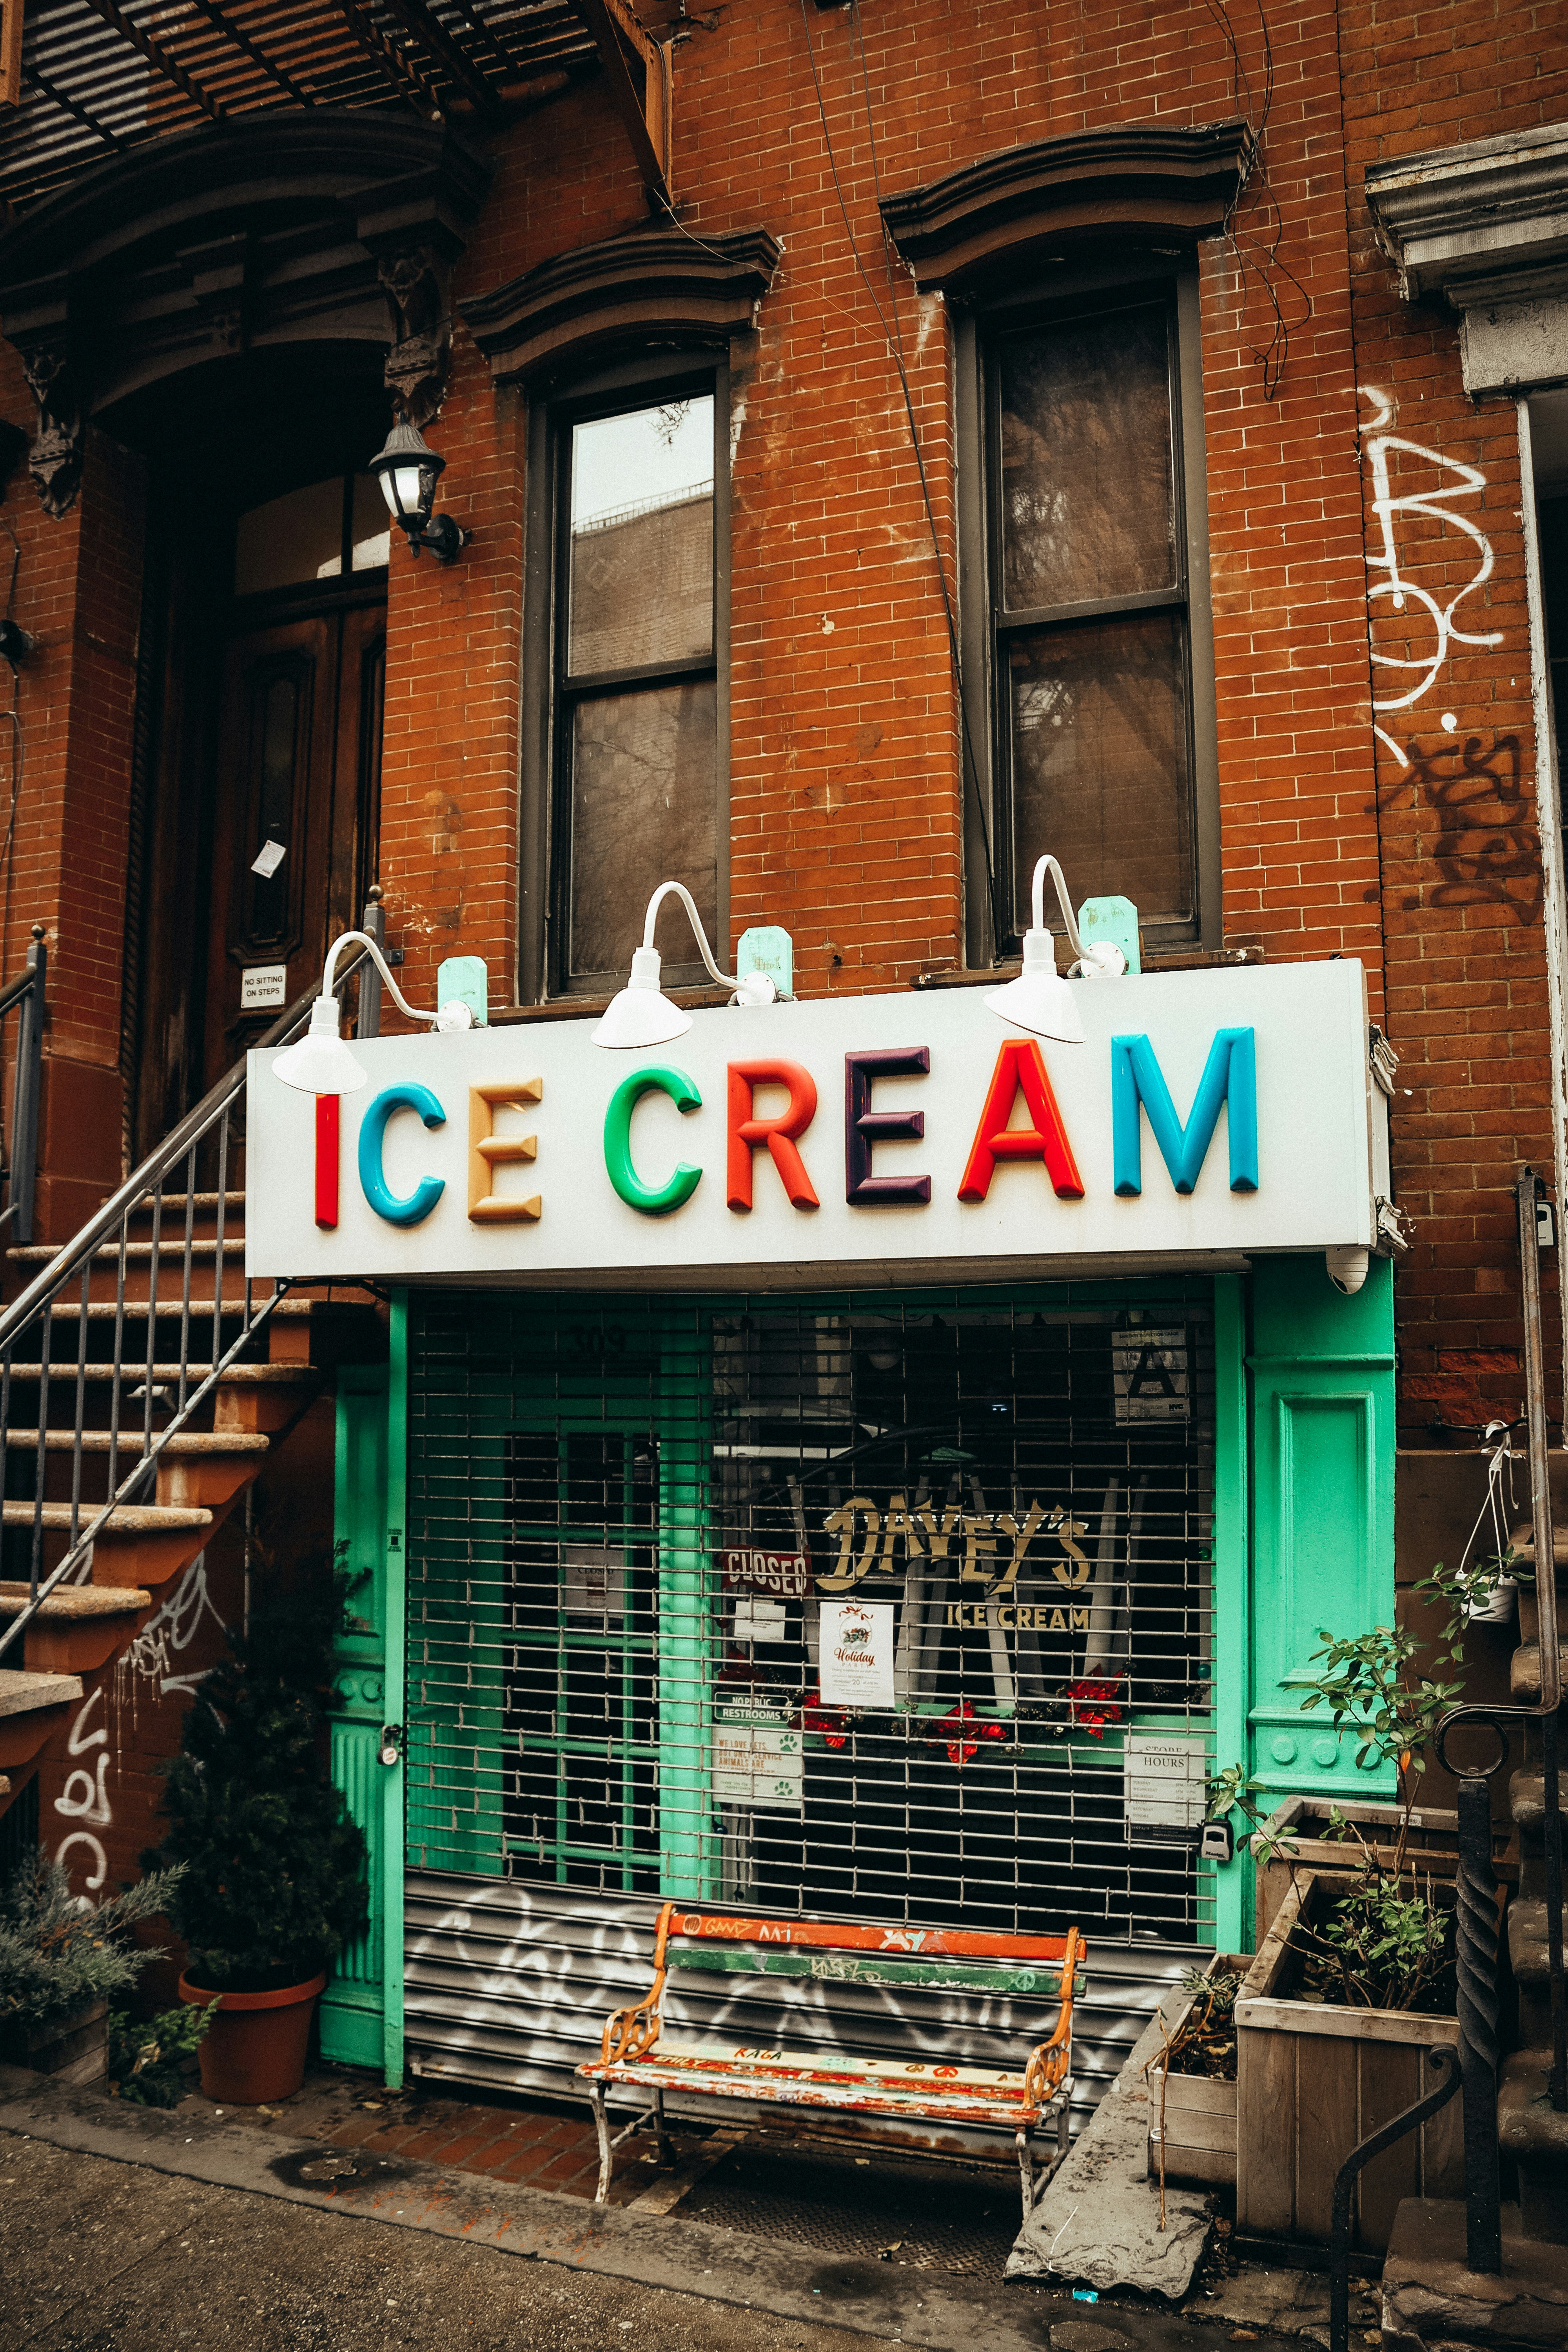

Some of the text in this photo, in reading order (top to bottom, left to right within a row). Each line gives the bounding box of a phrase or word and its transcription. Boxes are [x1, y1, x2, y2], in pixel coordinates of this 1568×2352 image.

[256, 976, 283, 984] SITTING
[314, 1026, 1259, 1230] ICE CREAM
[1129, 1342, 1176, 1394] A
[728, 1553, 807, 1594] CLOSED
[947, 1605, 1089, 1630] ICE CREAM
[834, 1647, 875, 1666] Holiday
[732, 1697, 744, 1705] NO
[722, 1708, 780, 1720] RESTROOMS
[731, 1740, 747, 1749] LOVE
[719, 1757, 764, 1768] ANIMALS ARE
[1144, 1757, 1184, 1768] HOURS
